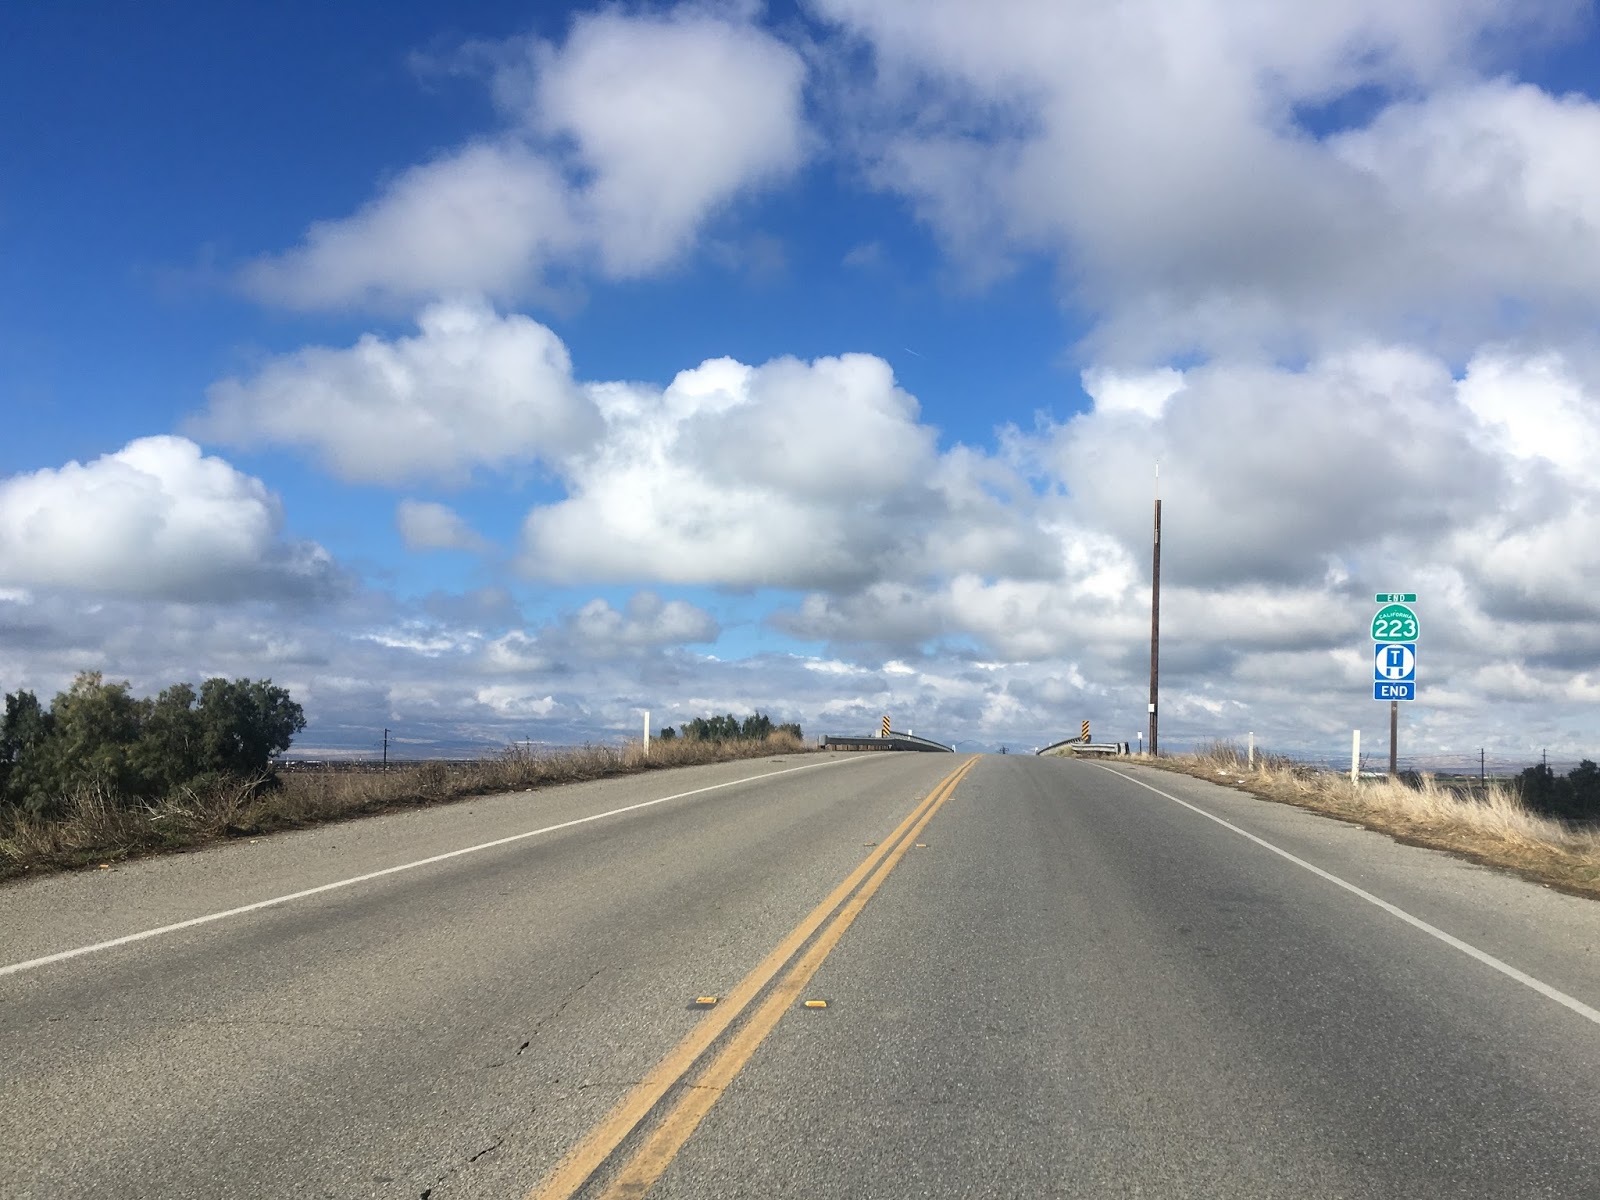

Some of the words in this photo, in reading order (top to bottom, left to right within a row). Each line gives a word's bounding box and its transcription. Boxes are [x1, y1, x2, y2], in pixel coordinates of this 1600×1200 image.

[1387, 594, 1405, 602] END
[1375, 620, 1416, 637] 223
[1390, 650, 1400, 665] T
[1381, 685, 1408, 697] END
